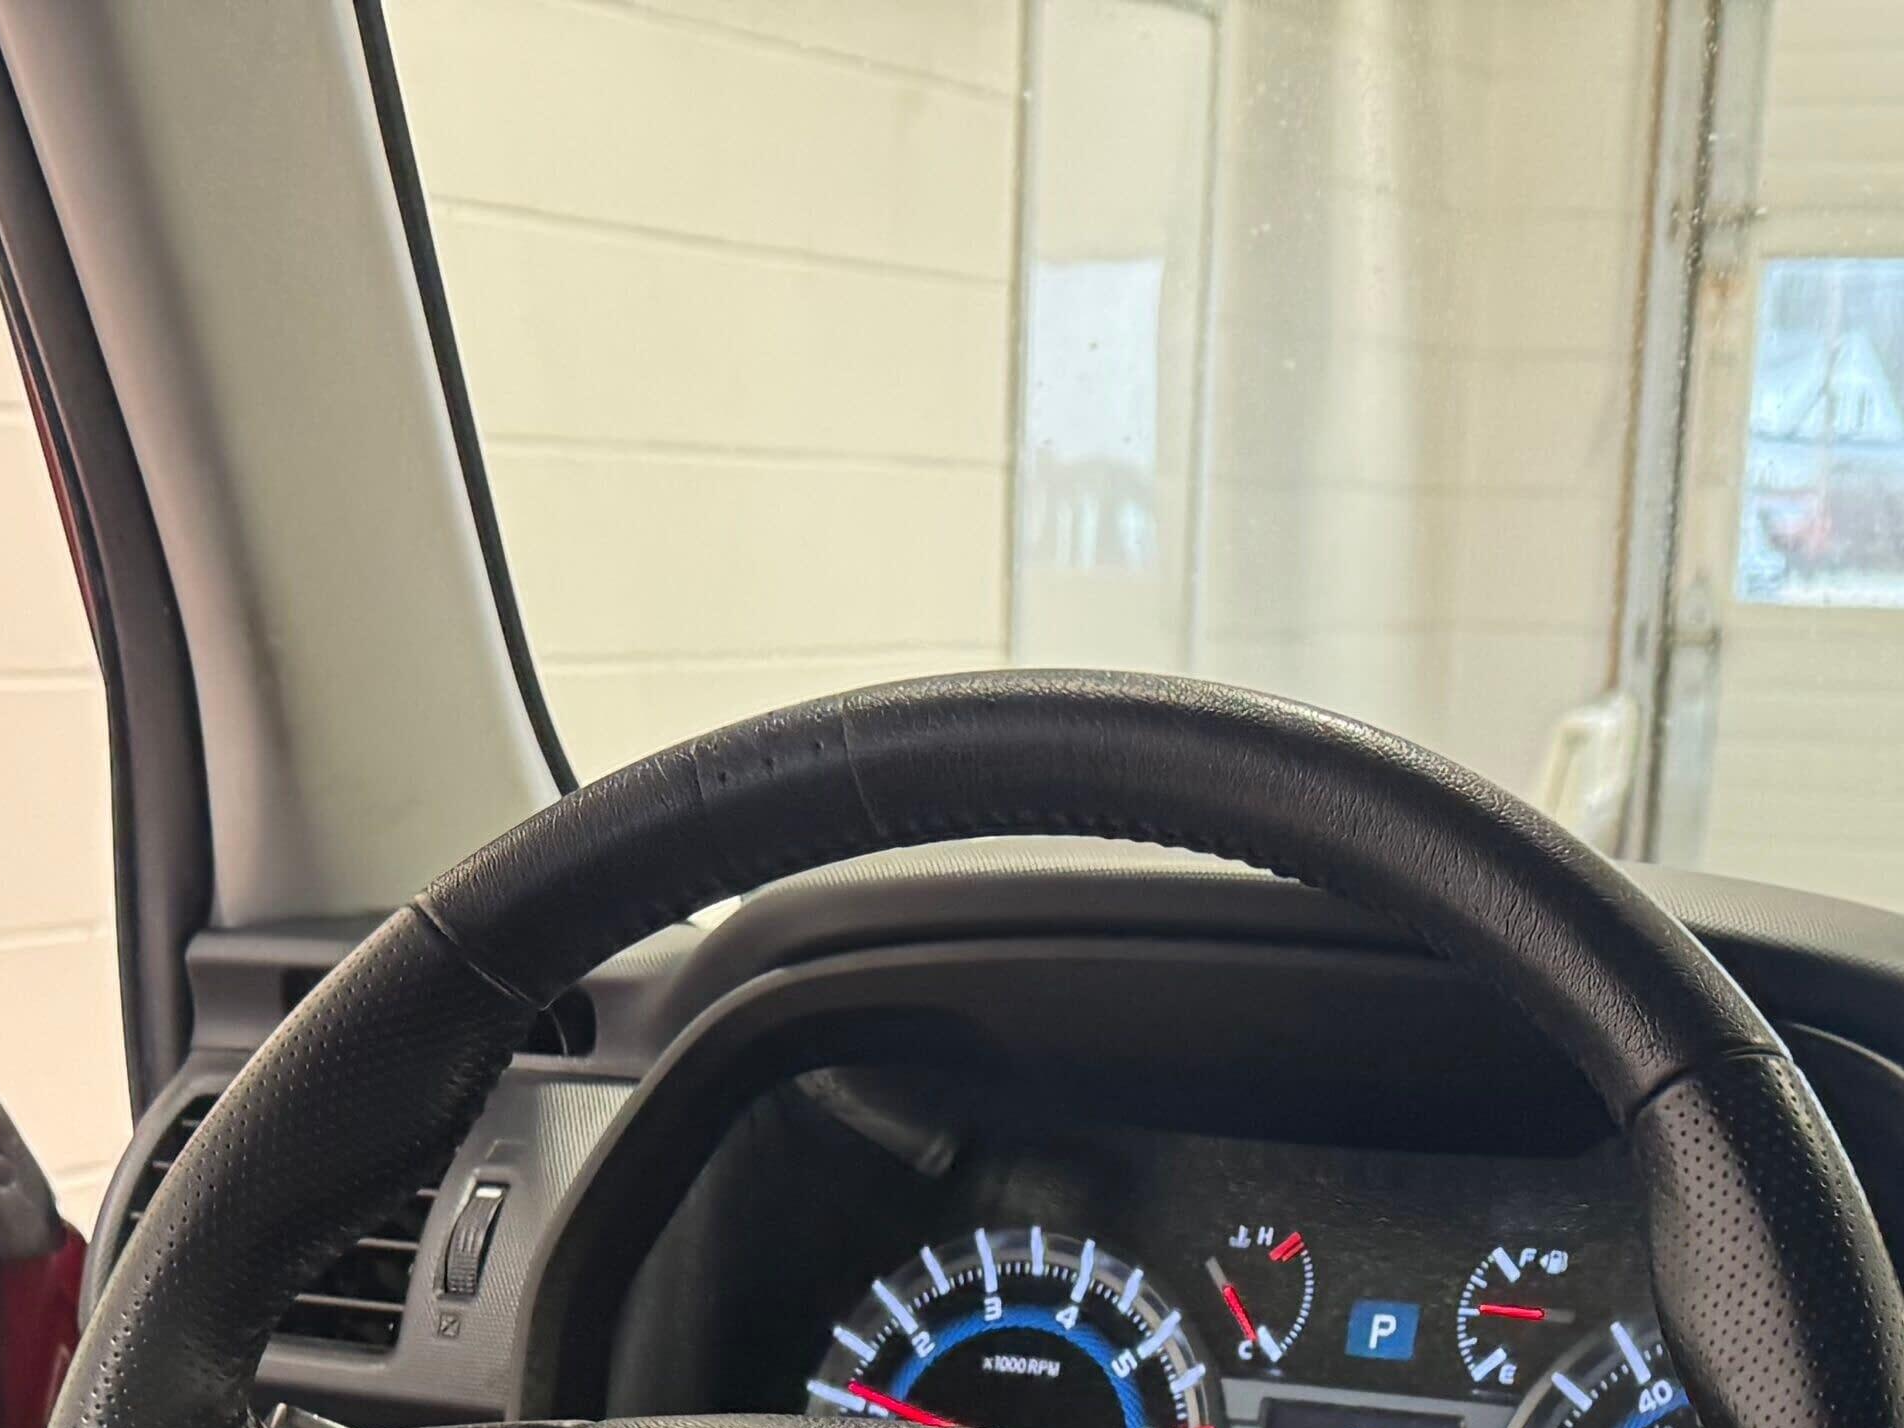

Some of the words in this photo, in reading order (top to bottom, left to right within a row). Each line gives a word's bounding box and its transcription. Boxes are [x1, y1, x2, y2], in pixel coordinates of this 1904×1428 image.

[983, 1296, 1003, 1322] 3
[1055, 1304, 1080, 1329] 4
[1368, 1313, 1399, 1350] P
[1112, 1352, 1139, 1379] 5
[1637, 1378, 1674, 1415] 40
